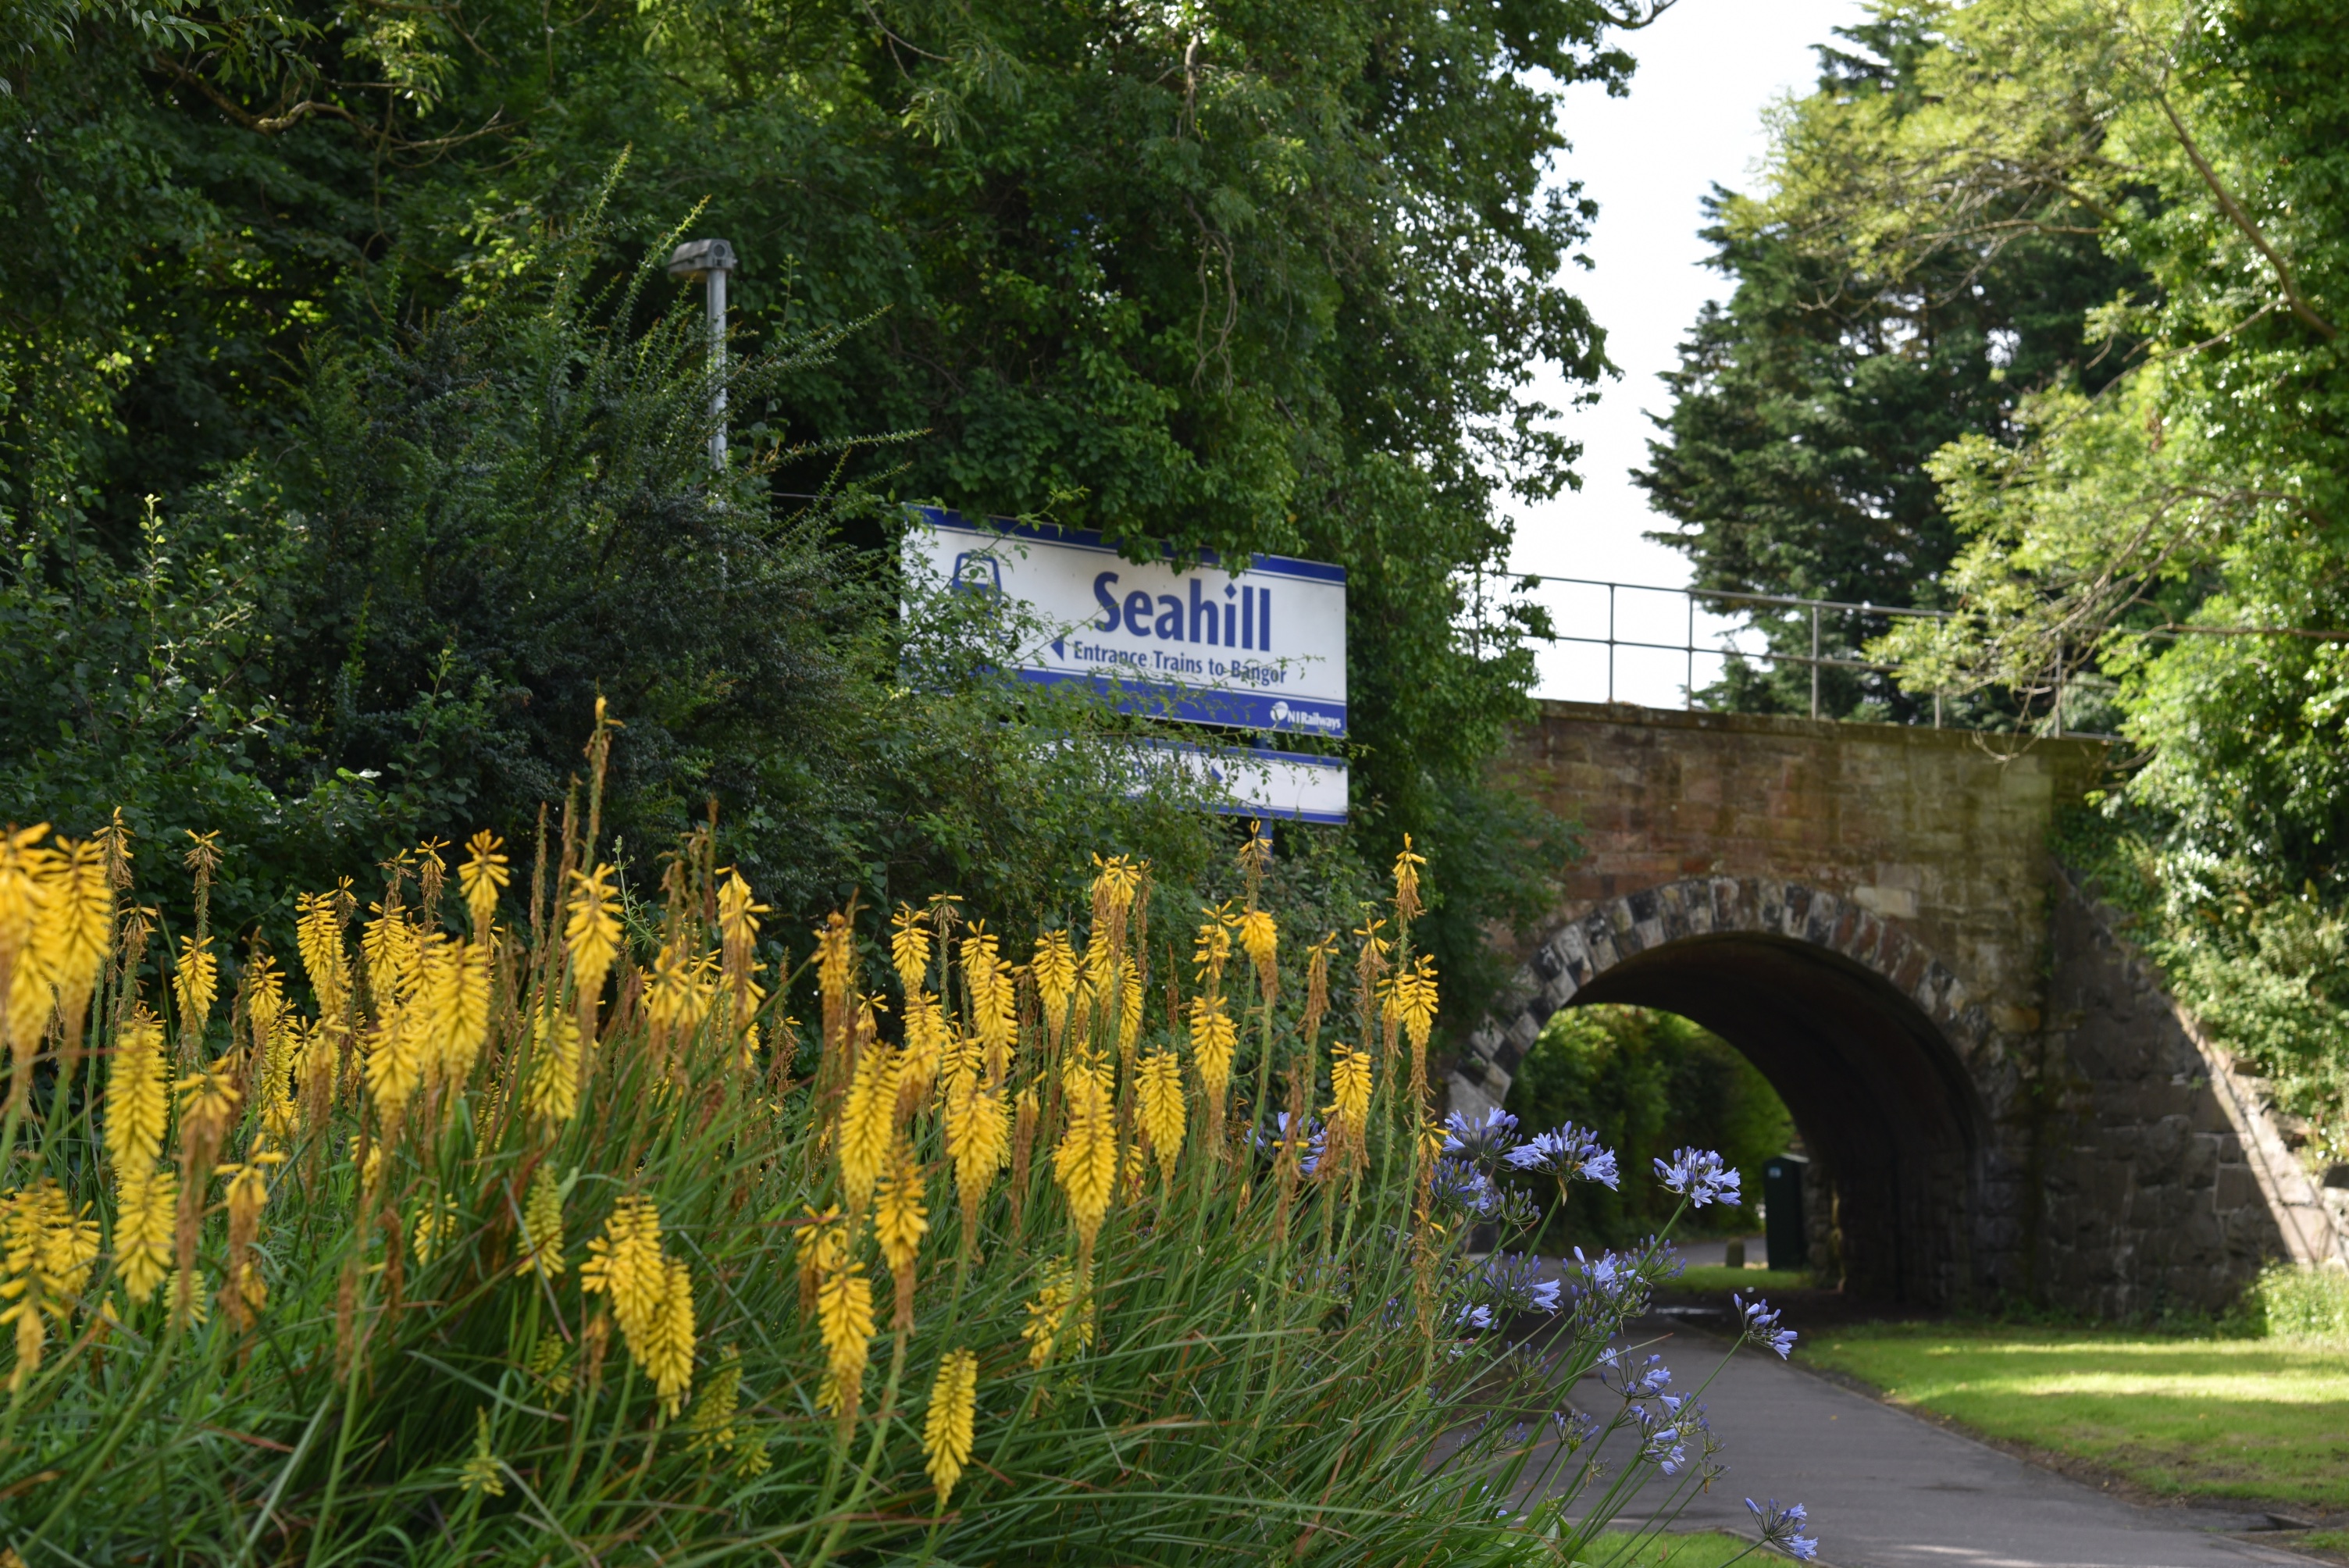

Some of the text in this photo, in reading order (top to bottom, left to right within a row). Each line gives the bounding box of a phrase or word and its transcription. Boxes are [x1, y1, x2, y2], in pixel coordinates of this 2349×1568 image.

[1094, 571, 1271, 652] Seahill
[1074, 640, 1287, 686] Entrance Trains to Bangor
